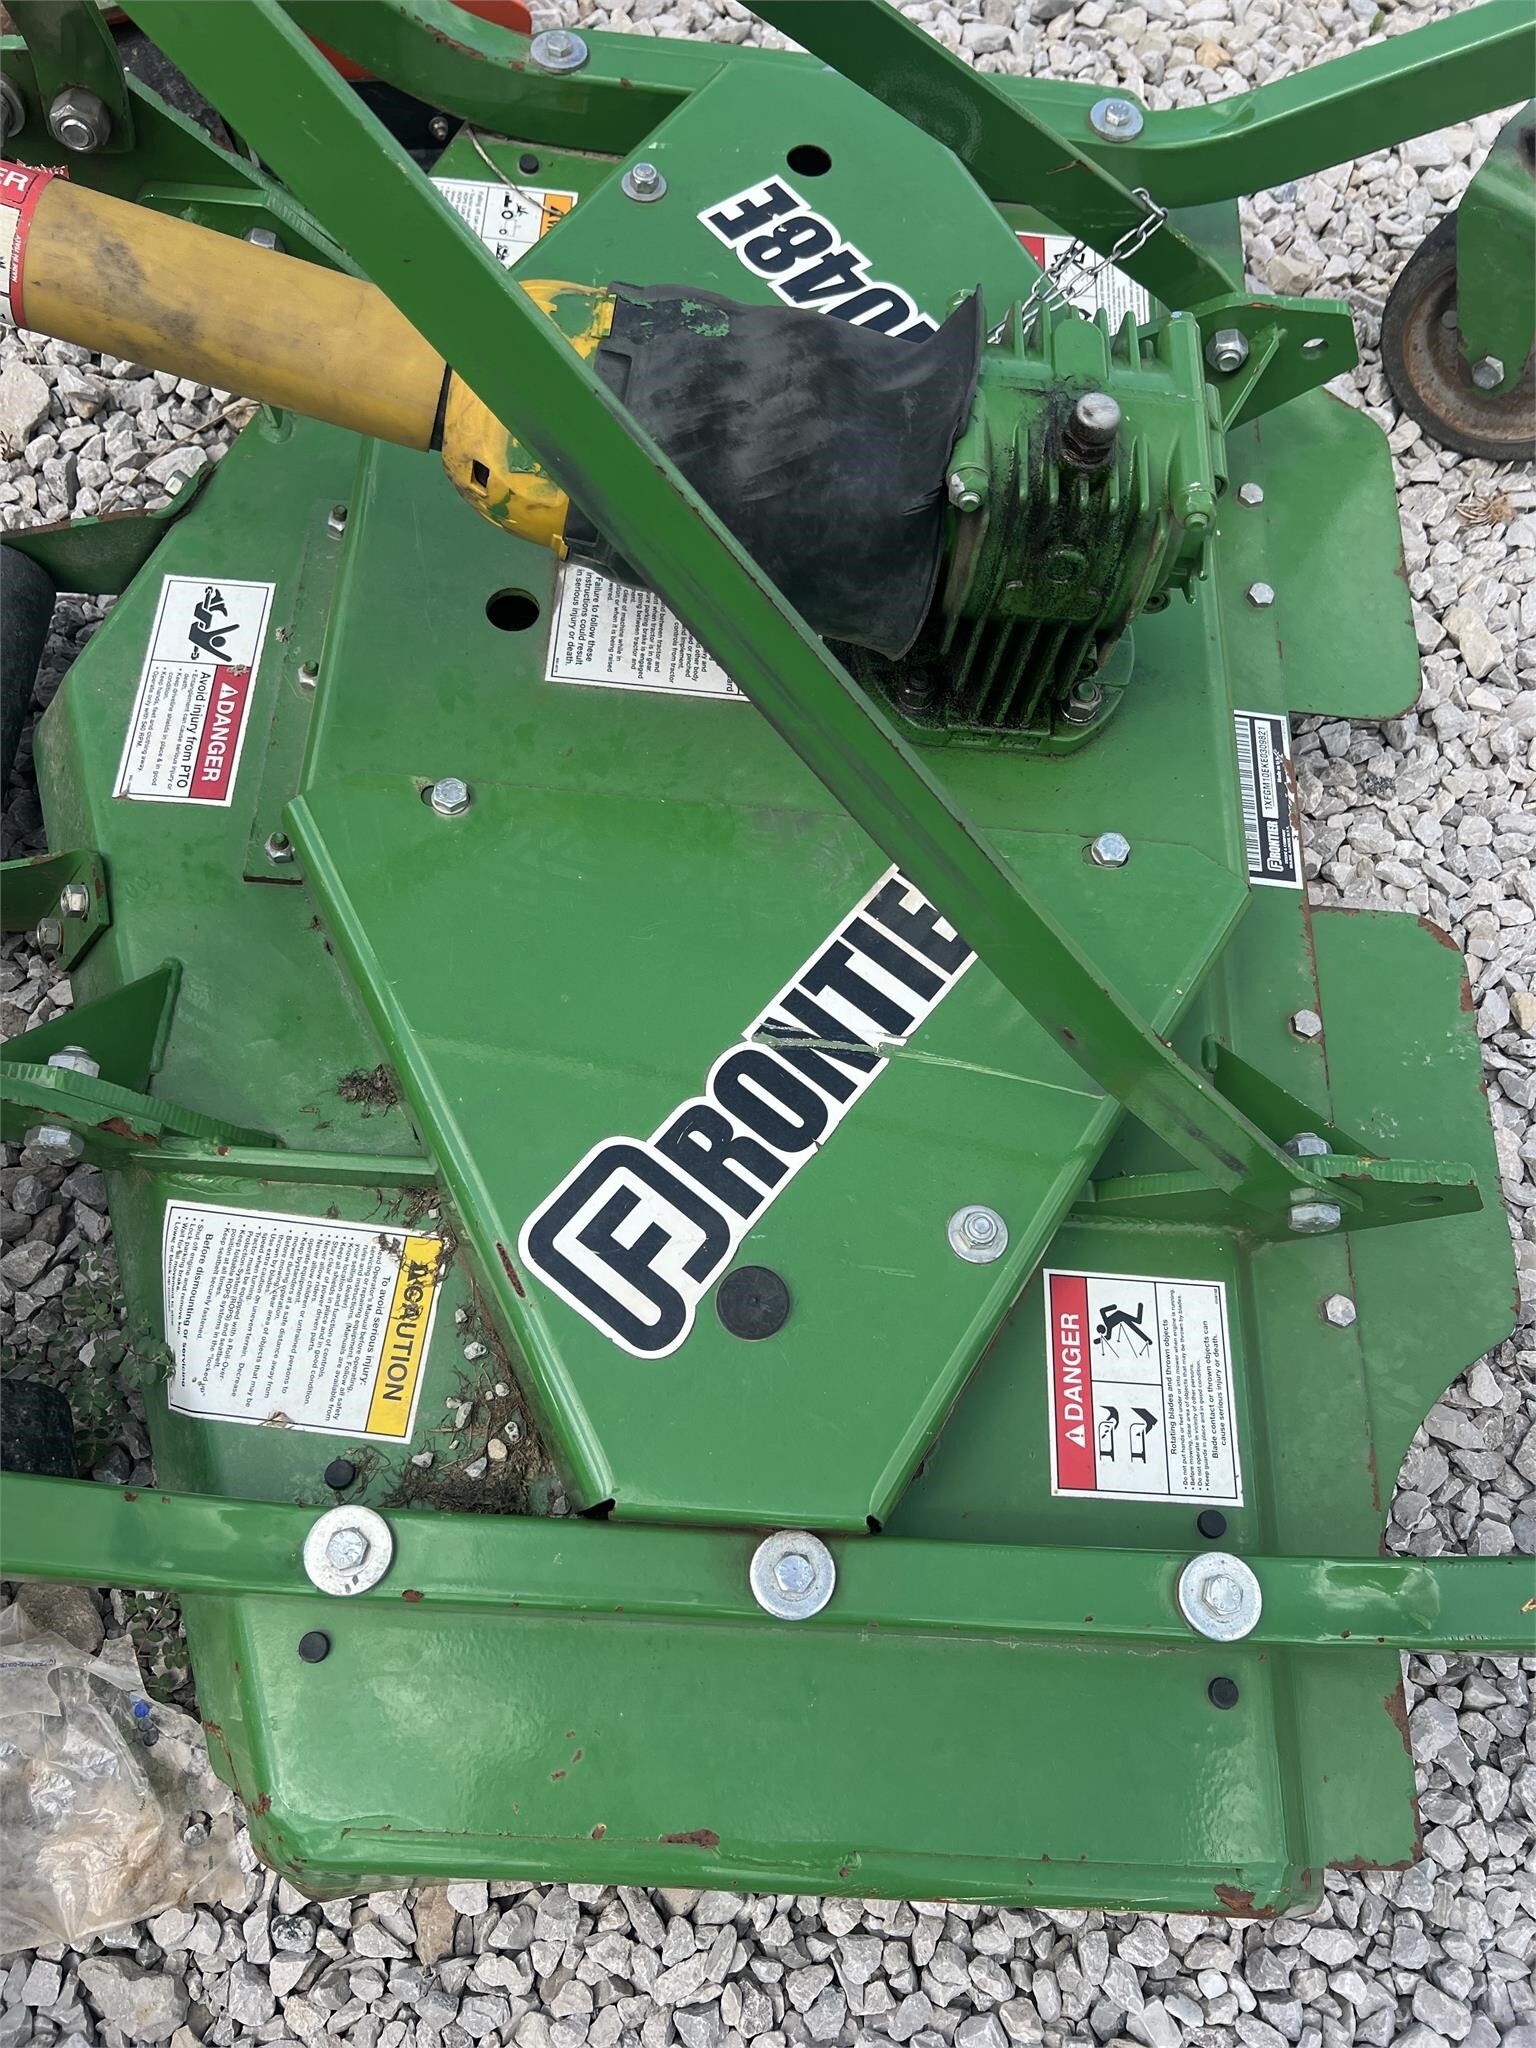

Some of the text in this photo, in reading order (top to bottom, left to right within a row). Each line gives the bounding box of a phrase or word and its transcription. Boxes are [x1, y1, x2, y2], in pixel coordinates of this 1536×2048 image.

[707, 182, 937, 344] 048E
[564, 567, 585, 666] in serious injury or death.
[574, 570, 593, 665] instructions could result
[584, 575, 604, 662] Failure to follow these
[640, 603, 650, 627] parking
[640, 627, 649, 645] brake
[667, 621, 680, 684] controls from tractor
[636, 651, 645, 679] engaged
[147, 669, 160, 693] Operate
[157, 670, 167, 686] Keep
[172, 671, 182, 687] Keep
[143, 693, 153, 706] only
[149, 705, 159, 718] feet
[167, 687, 178, 712] driveline
[138, 719, 148, 732] 540
[146, 718, 155, 731] and
[162, 712, 172, 733] shields
[166, 672, 199, 790] Entanglement can cause serious injury or
[175, 670, 211, 788] Avoid injury from PTO
[140, 730, 152, 755] clothing
[157, 740, 166, 757] place
[200, 699, 235, 781] DANGER
[150, 769, 159, 786] good
[154, 762, 162, 770] in
[1265, 819, 1284, 872] FRONTIER
[527, 876, 974, 1352] FRONTIE
[197, 1232, 214, 1264] Before
[343, 1241, 354, 1263] Know
[359, 1243, 369, 1262] rules
[356, 1261, 365, 1277] and
[363, 1244, 377, 1277] servicing
[336, 1262, 349, 1292] location
[362, 1276, 369, 1286] or
[182, 1265, 204, 1326] dismounting
[333, 1292, 342, 1307] and
[353, 1285, 367, 1319] repairing
[326, 1307, 340, 1338] function
[1177, 1314, 1184, 1322] by
[324, 1337, 332, 1347] of
[358, 1275, 391, 1386] To avoid serious injury:
[381, 1285, 424, 1402] CAUTION
[1179, 1342, 1186, 1352] be
[335, 1355, 344, 1369] are
[340, 1360, 352, 1386] Follow
[1059, 1312, 1083, 1421] DANGER
[328, 1369, 341, 1402] available
[1161, 1318, 1177, 1455] Rotating blades and thrown objects
[1176, 1387, 1182, 1395] or
[1182, 1377, 1190, 1401] objects
[1196, 1388, 1205, 1404] good
[1201, 1319, 1219, 1459] Blade contact or thrown objects can
[1211, 1333, 1227, 1446] cause serious injury or death.
[324, 1403, 335, 1422] from
[332, 1396, 343, 1420] safety
[1183, 1400, 1190, 1408] of
[1190, 1404, 1198, 1412] of
[1179, 1425, 1185, 1434] or
[1180, 1453, 1188, 1465] put
[1194, 1440, 1202, 1465] operate
[1201, 1448, 1210, 1470] guards
[1181, 1475, 1189, 1486] Do
[1188, 1464, 1196, 1486] Before
[1196, 1476, 1203, 1487] Do
